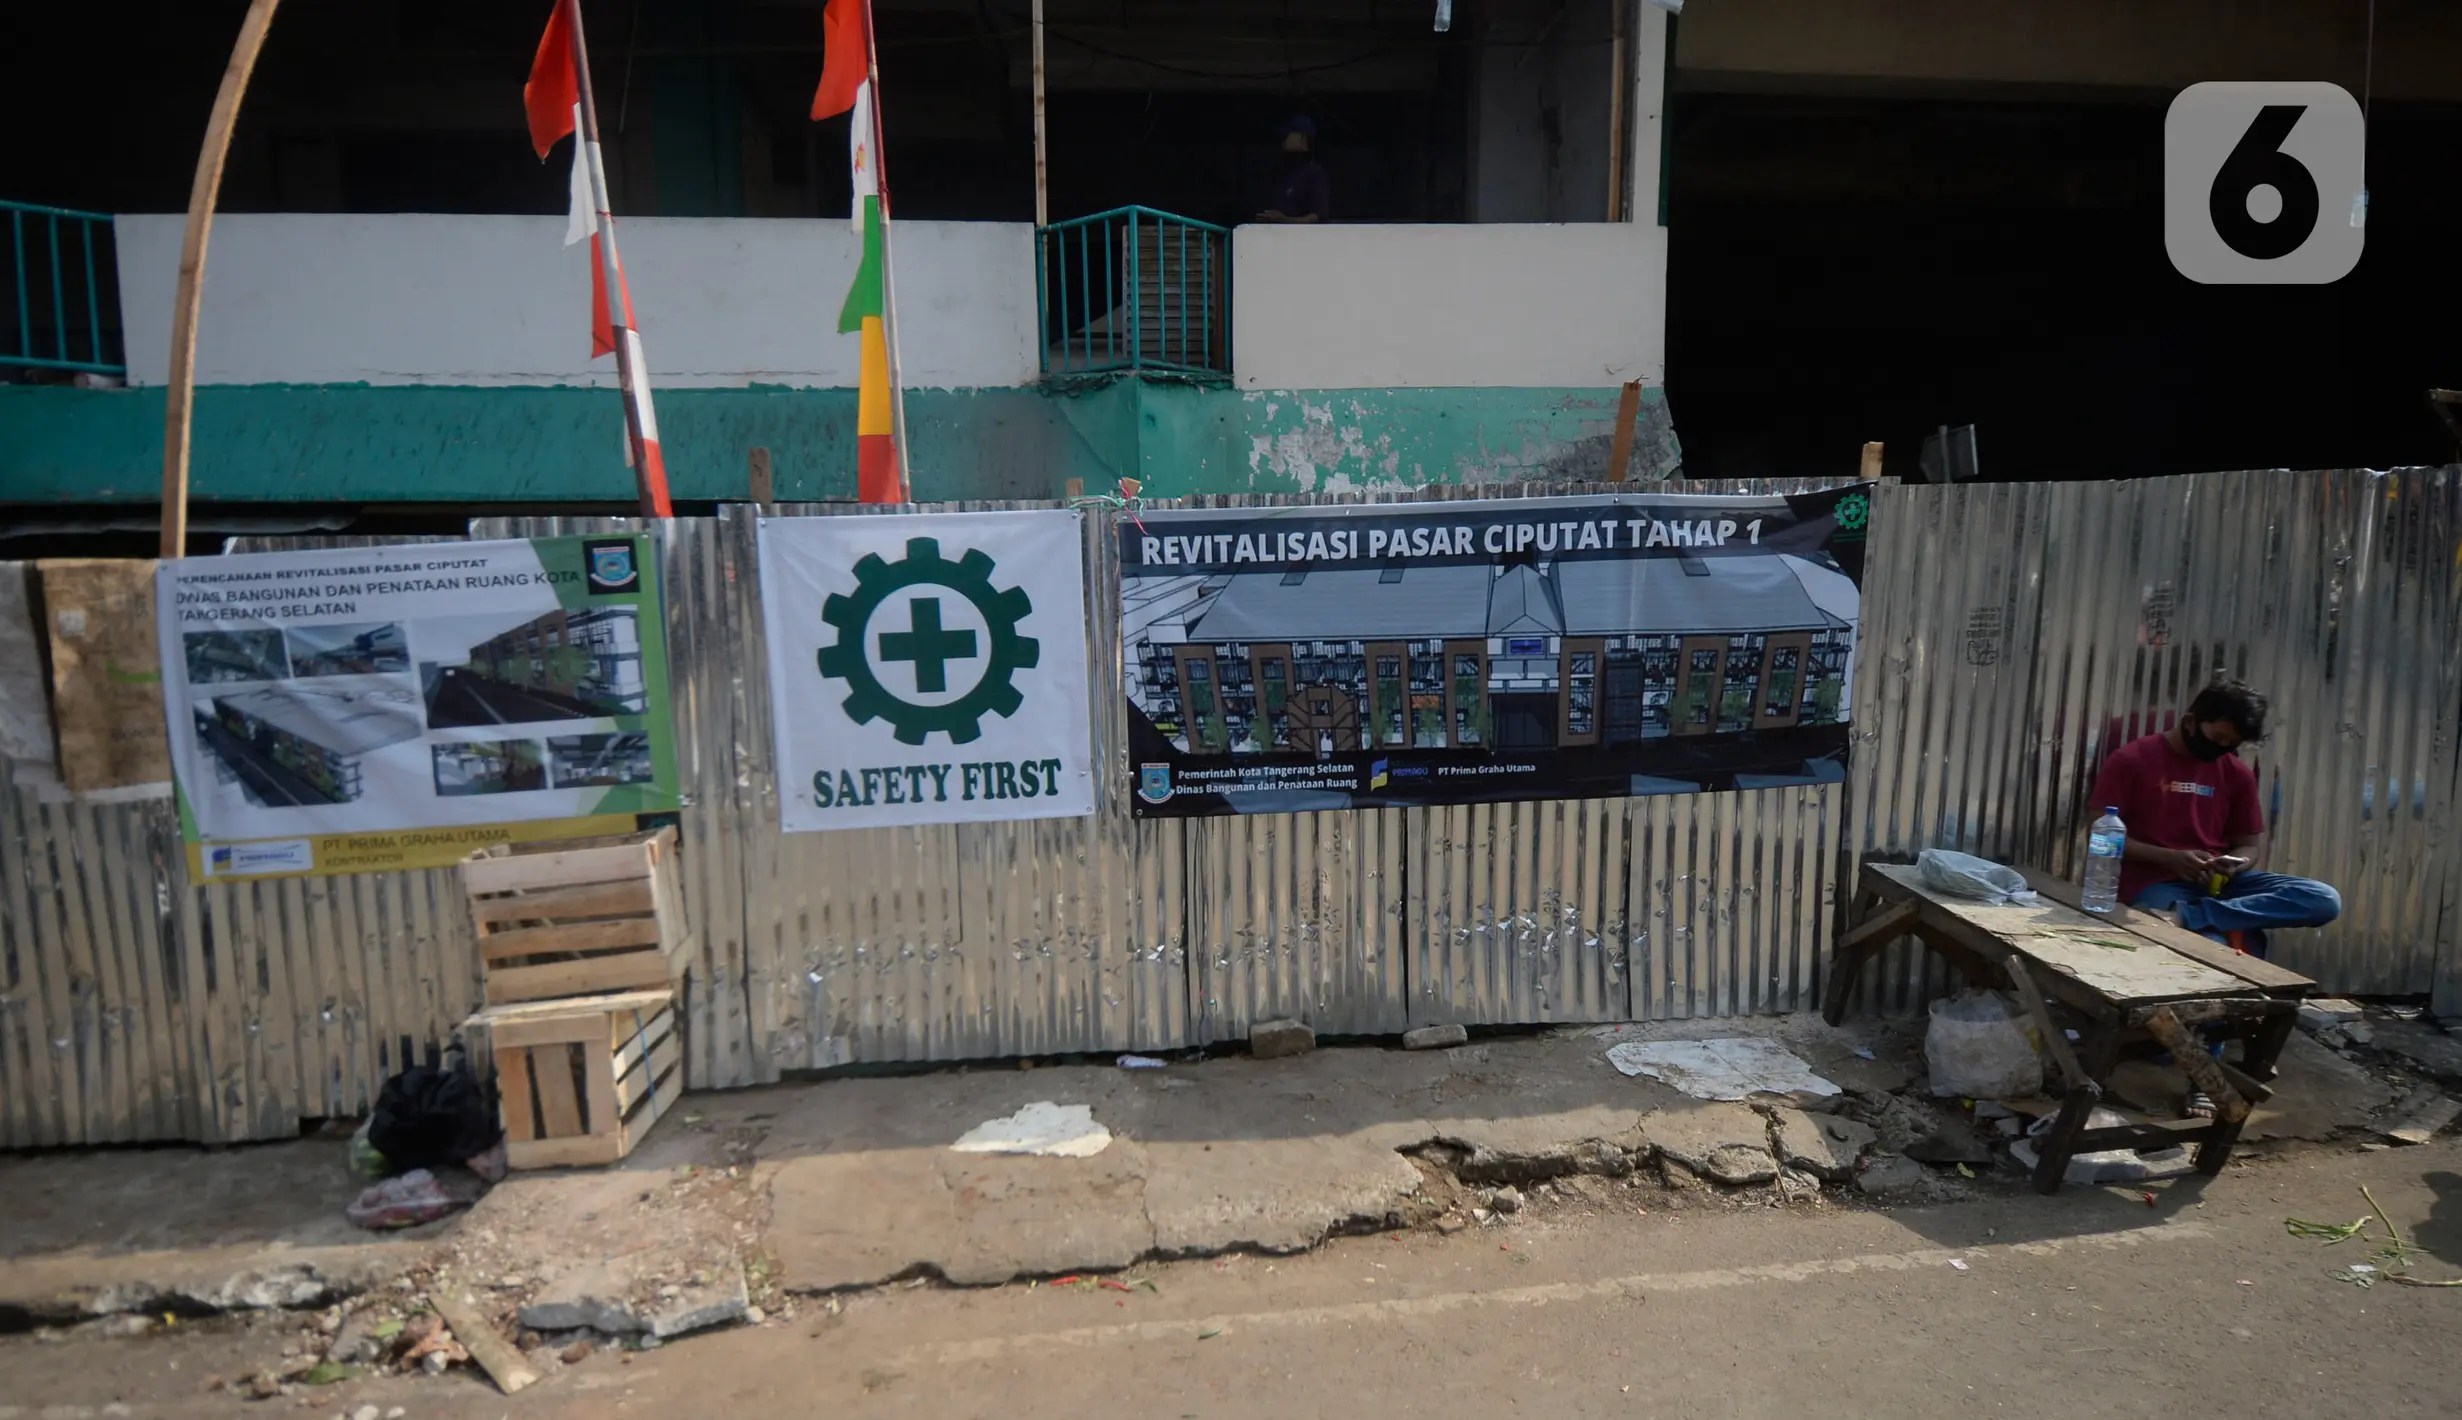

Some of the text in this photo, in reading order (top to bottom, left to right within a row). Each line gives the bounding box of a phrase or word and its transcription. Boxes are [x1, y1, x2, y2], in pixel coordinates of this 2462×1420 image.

[1141, 518, 1763, 565] REVITALISASI PASAR CIPUTAT TAHAP 1
[276, 565, 370, 579] REVITALISASI
[375, 563, 422, 574] PASAR
[426, 559, 488, 570] CIPUTAT
[226, 586, 321, 603] BANGUNAN
[326, 584, 362, 598] DAN
[367, 578, 460, 595] PENATAAN
[465, 573, 529, 589] RUANG
[534, 570, 581, 584] KOTA
[280, 601, 356, 618] SELATAN
[1178, 763, 1354, 780] Pemerintah Kota Tangerang Selatan
[1438, 764, 1536, 775] PT Prima Graha Utama
[813, 758, 1062, 809] SAFETY FIRST
[1176, 777, 1358, 795] Dinas Bangunan dan Penataan Ruang
[322, 827, 511, 852] PT PRIMA GRAHA UTAMA
